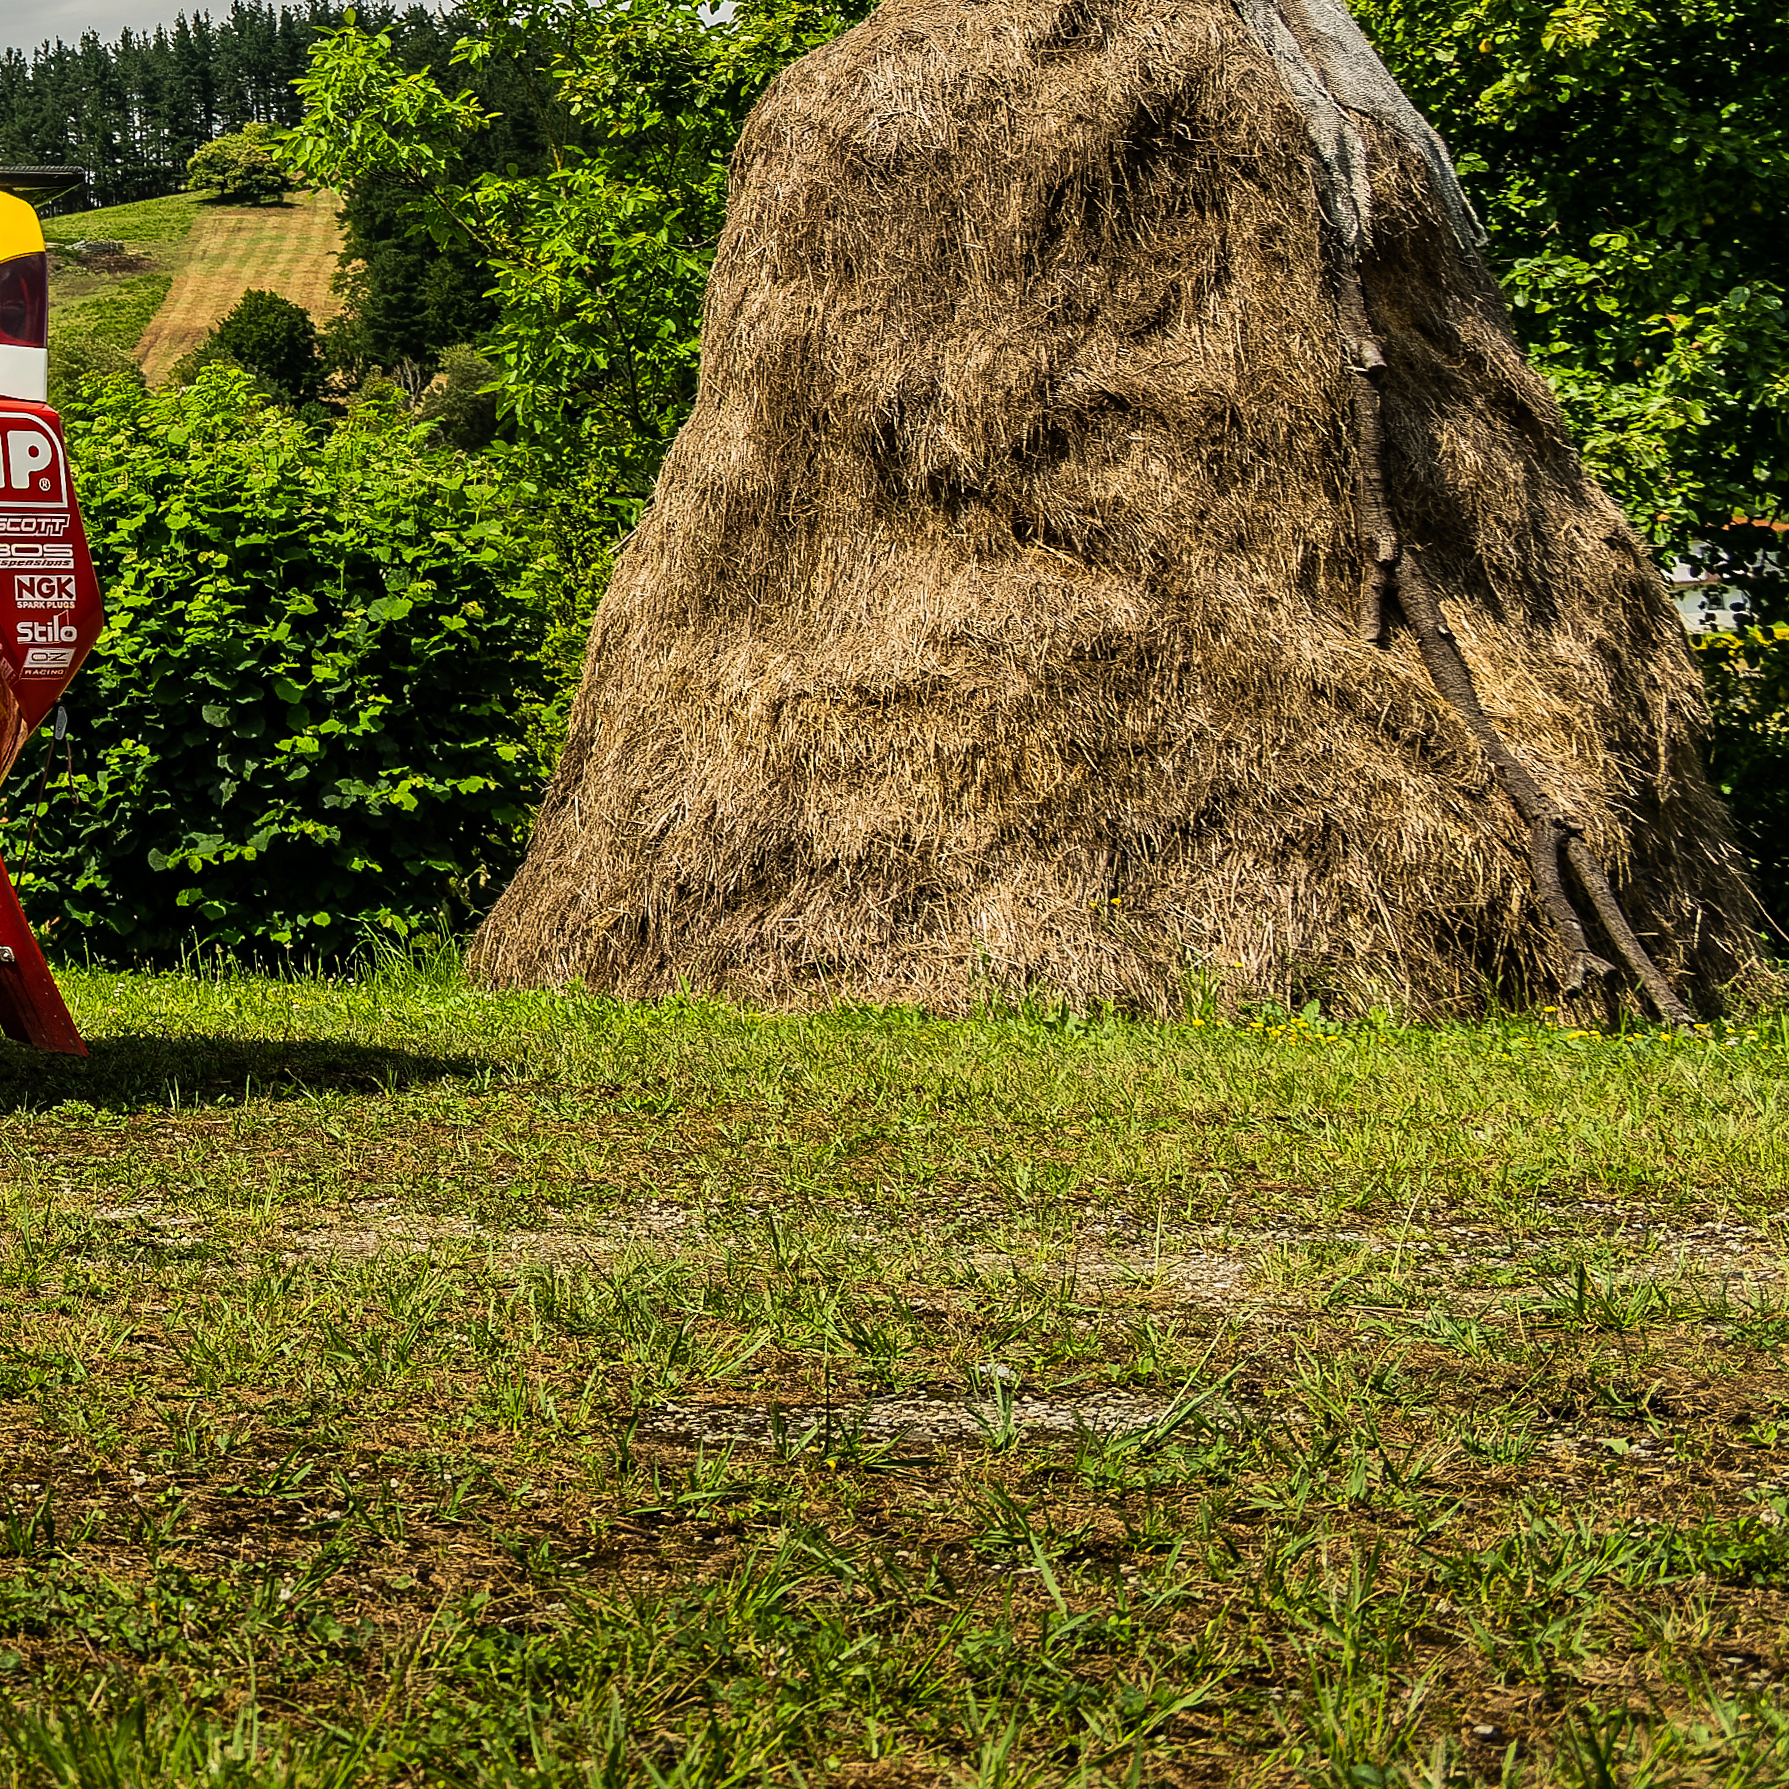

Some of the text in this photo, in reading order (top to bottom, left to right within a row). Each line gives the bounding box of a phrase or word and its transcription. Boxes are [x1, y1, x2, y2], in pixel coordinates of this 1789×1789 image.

[17, 576, 74, 599] NGK
[17, 601, 75, 609] SPARK PLUGS
[16, 613, 78, 642] Stilo
